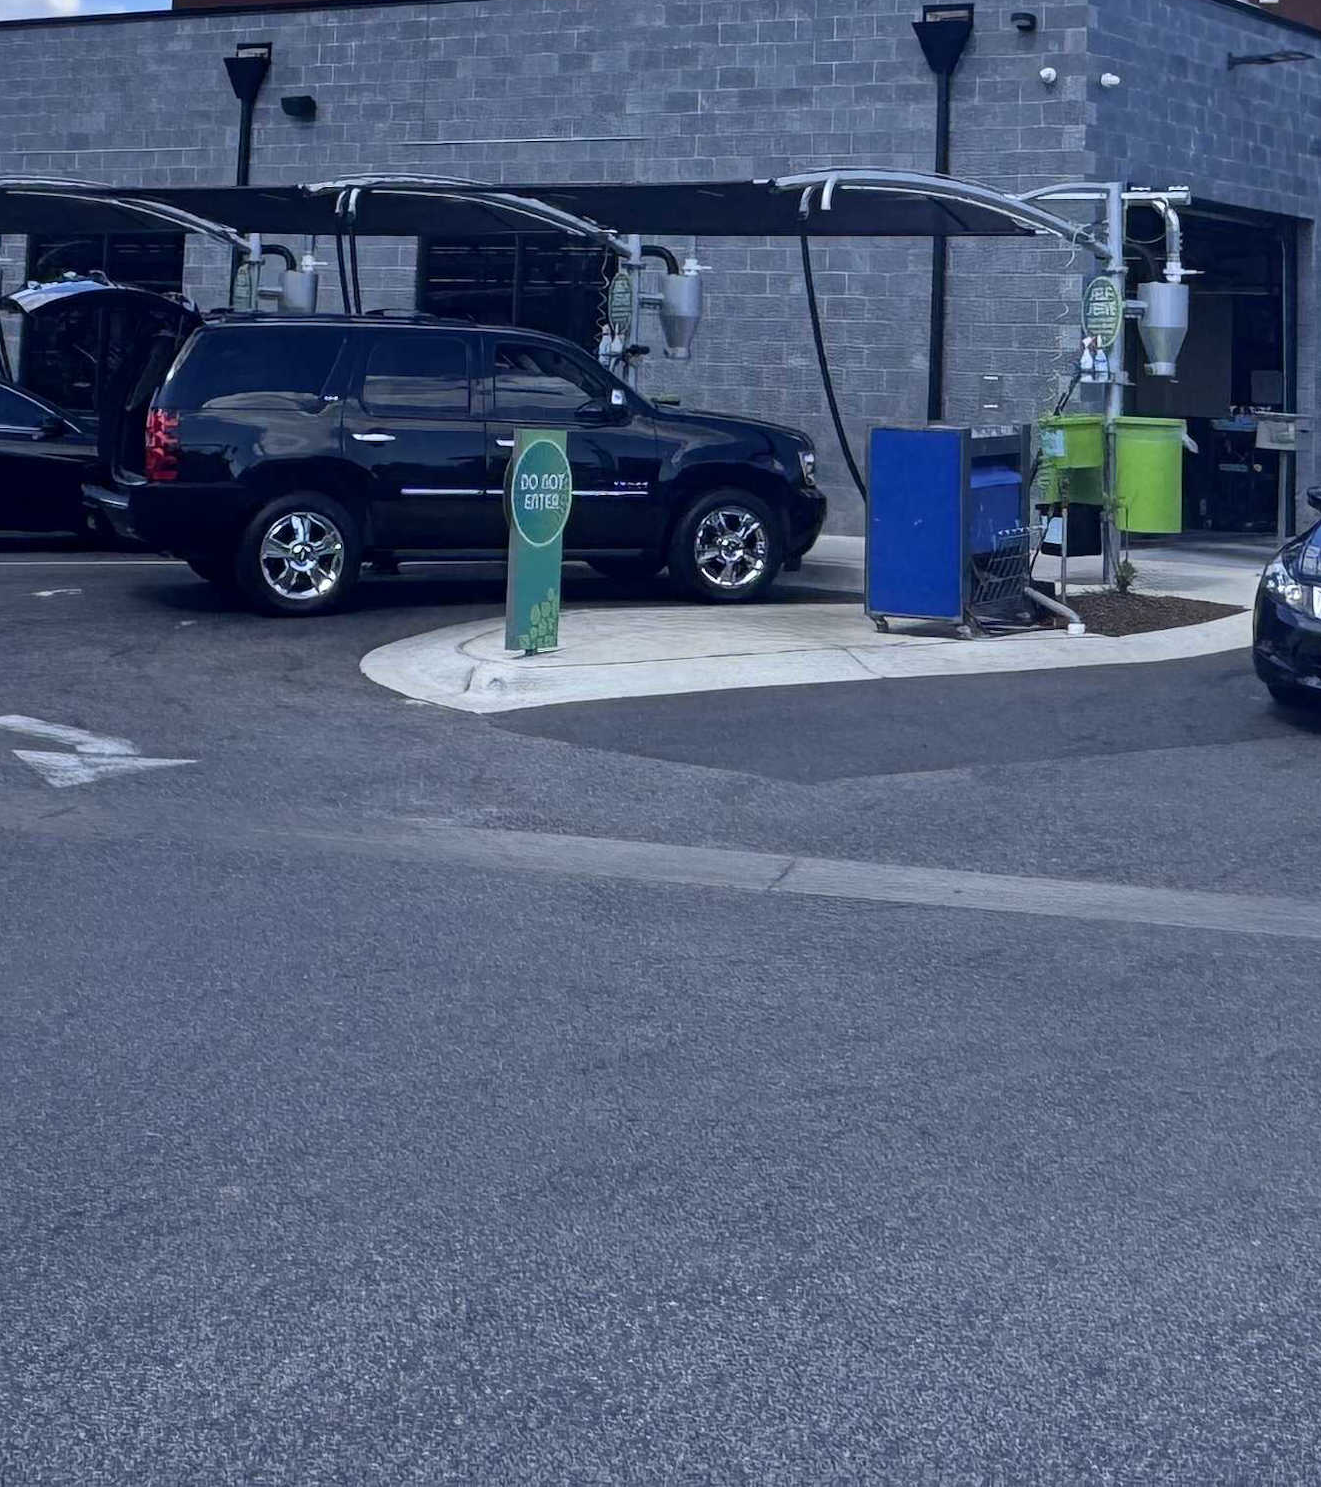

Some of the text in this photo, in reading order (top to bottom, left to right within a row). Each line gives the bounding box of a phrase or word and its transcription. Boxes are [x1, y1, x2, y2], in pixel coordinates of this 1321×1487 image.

[520, 473, 566, 490] DO NOT
[524, 493, 560, 510] ENTER
